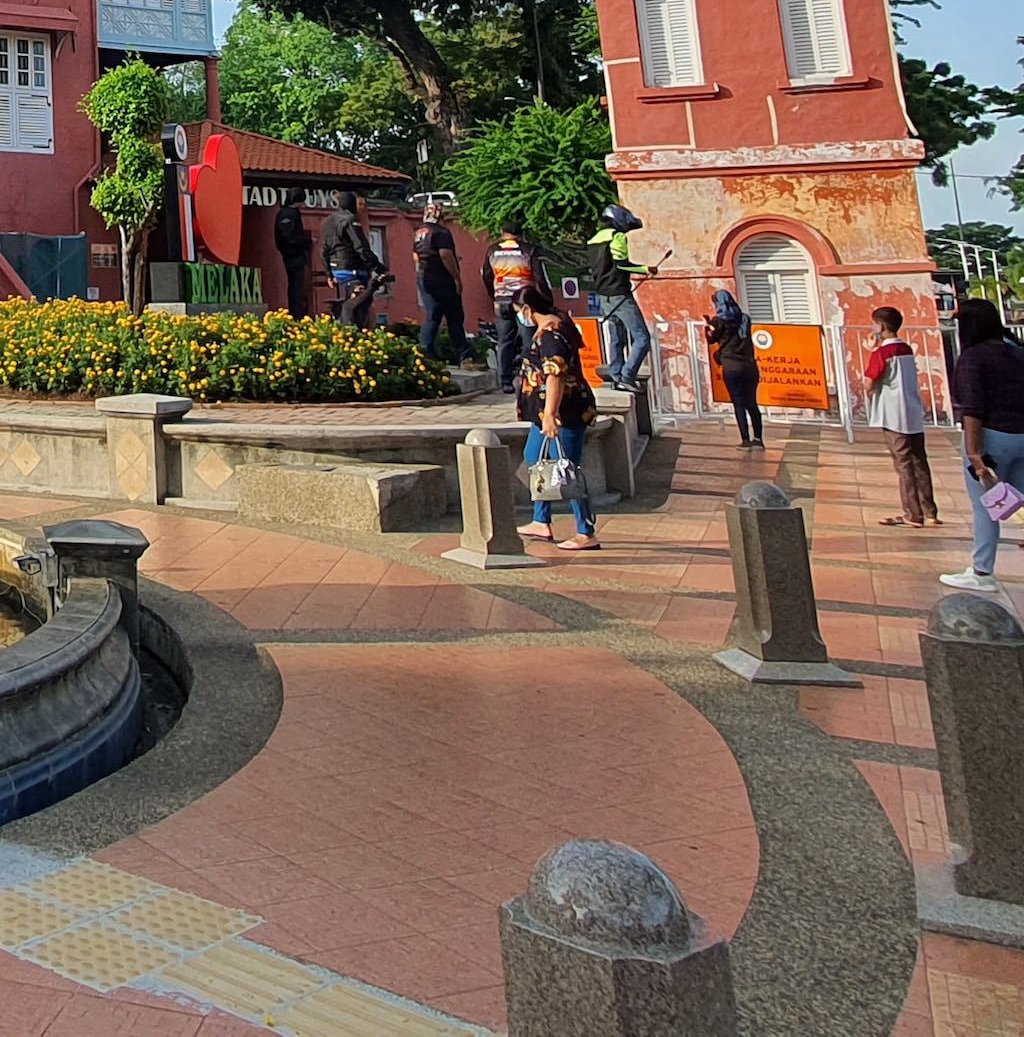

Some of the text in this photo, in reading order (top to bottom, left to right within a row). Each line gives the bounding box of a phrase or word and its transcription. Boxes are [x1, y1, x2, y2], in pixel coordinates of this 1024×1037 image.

[242, 185, 340, 208] TADTUYS
[189, 263, 263, 305] MELAKA
[756, 355, 800, 365] A-KERJA
[761, 366, 817, 376] NGGARAAN
